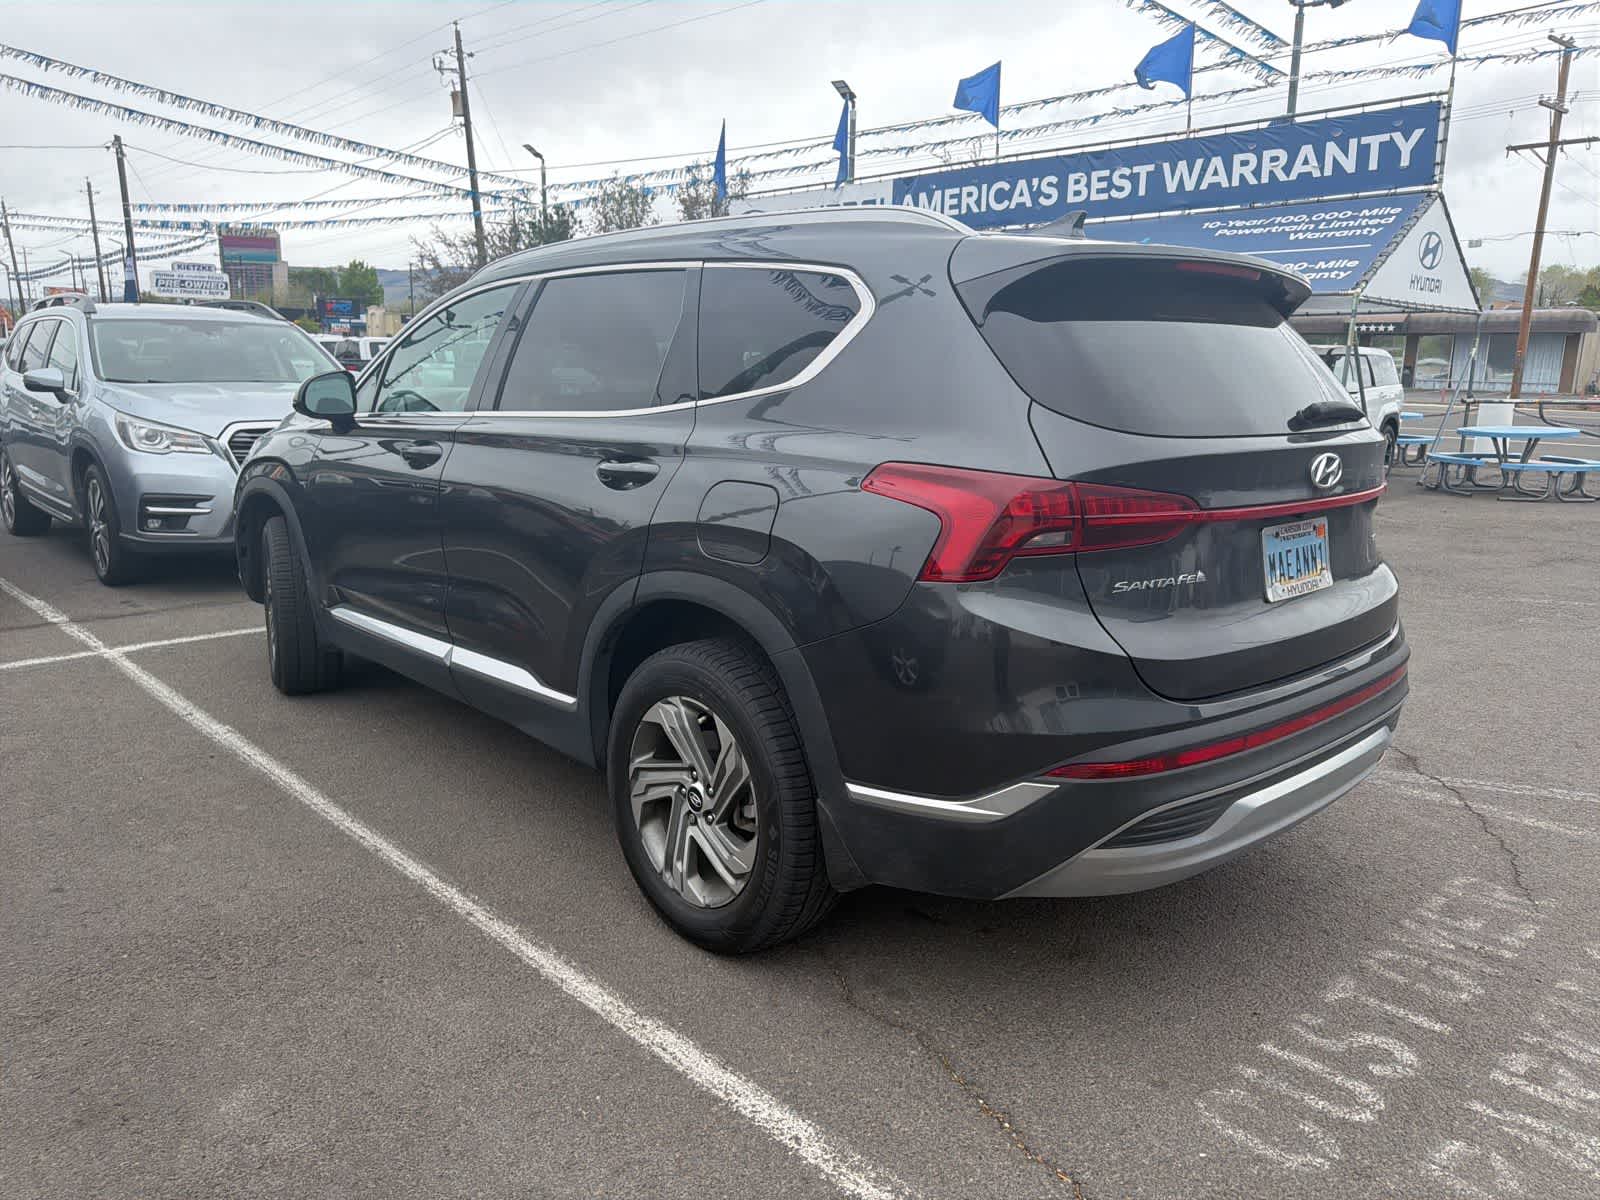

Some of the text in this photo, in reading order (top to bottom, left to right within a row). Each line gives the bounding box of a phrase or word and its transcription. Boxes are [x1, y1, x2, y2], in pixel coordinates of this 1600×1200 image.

[902, 127, 1426, 216] AMERICA'S BEST WARRANTY
[1201, 206, 1403, 229] 10-Year/100,000-Mile
[1215, 215, 1396, 237] Powertrain Limited
[1288, 226, 1384, 241] Warranty
[176, 263, 213, 272] KIETZKE
[158, 279, 226, 290] PRE-OWNED
[1410, 272, 1443, 294] HYUNDAI
[1267, 541, 1326, 585] MAEANN1
[1286, 579, 1319, 596] HYUNDAI
